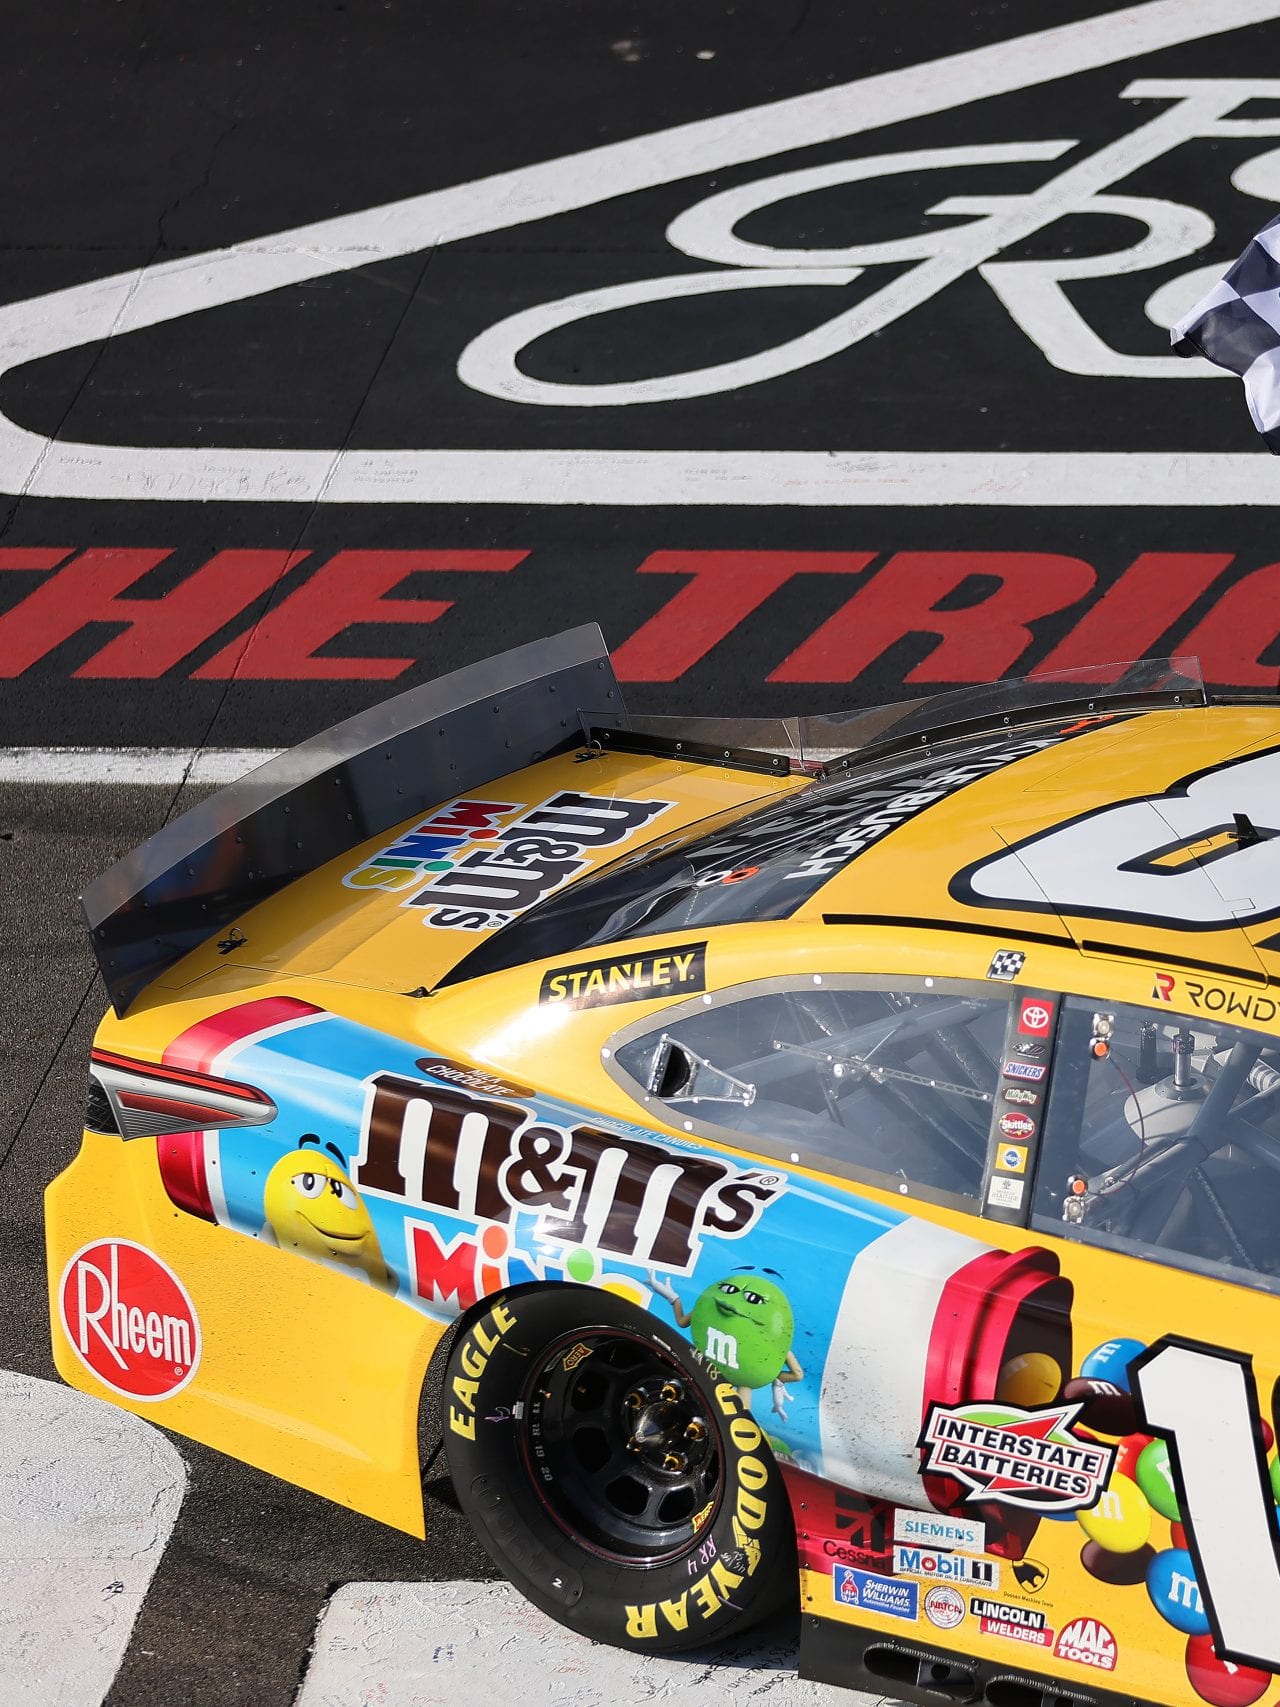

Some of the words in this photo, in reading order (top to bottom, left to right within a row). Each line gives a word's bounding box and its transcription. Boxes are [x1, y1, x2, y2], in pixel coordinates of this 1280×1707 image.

[783, 790, 949, 880] BUSCH
[549, 953, 695, 1002] STANLEY
[426, 1063, 514, 1098] CHOCOLATE
[1005, 1063, 1045, 1079] SNICKERS
[591, 1116, 654, 1140] CHOCOLATE
[1001, 1119, 1033, 1133] Skittles
[356, 1074, 778, 1268] m&m's
[78, 1260, 192, 1370] Rheem
[705, 1326, 739, 1370] m
[450, 1297, 518, 1441] EAGLE
[937, 1418, 1100, 1474] INTERSTATE
[942, 1444, 1089, 1495] BATTERIES
[905, 1519, 975, 1542] SIEMENS
[900, 1548, 965, 1577] Mobil
[862, 1587, 911, 1608] WILLIAMS
[866, 1578, 910, 1598] SHERWIN
[973, 1599, 1044, 1629] LINCOLN
[987, 1620, 1045, 1645] WELDERS
[1060, 1619, 1115, 1657] MAC
[1057, 1647, 1113, 1670] TOOLS
